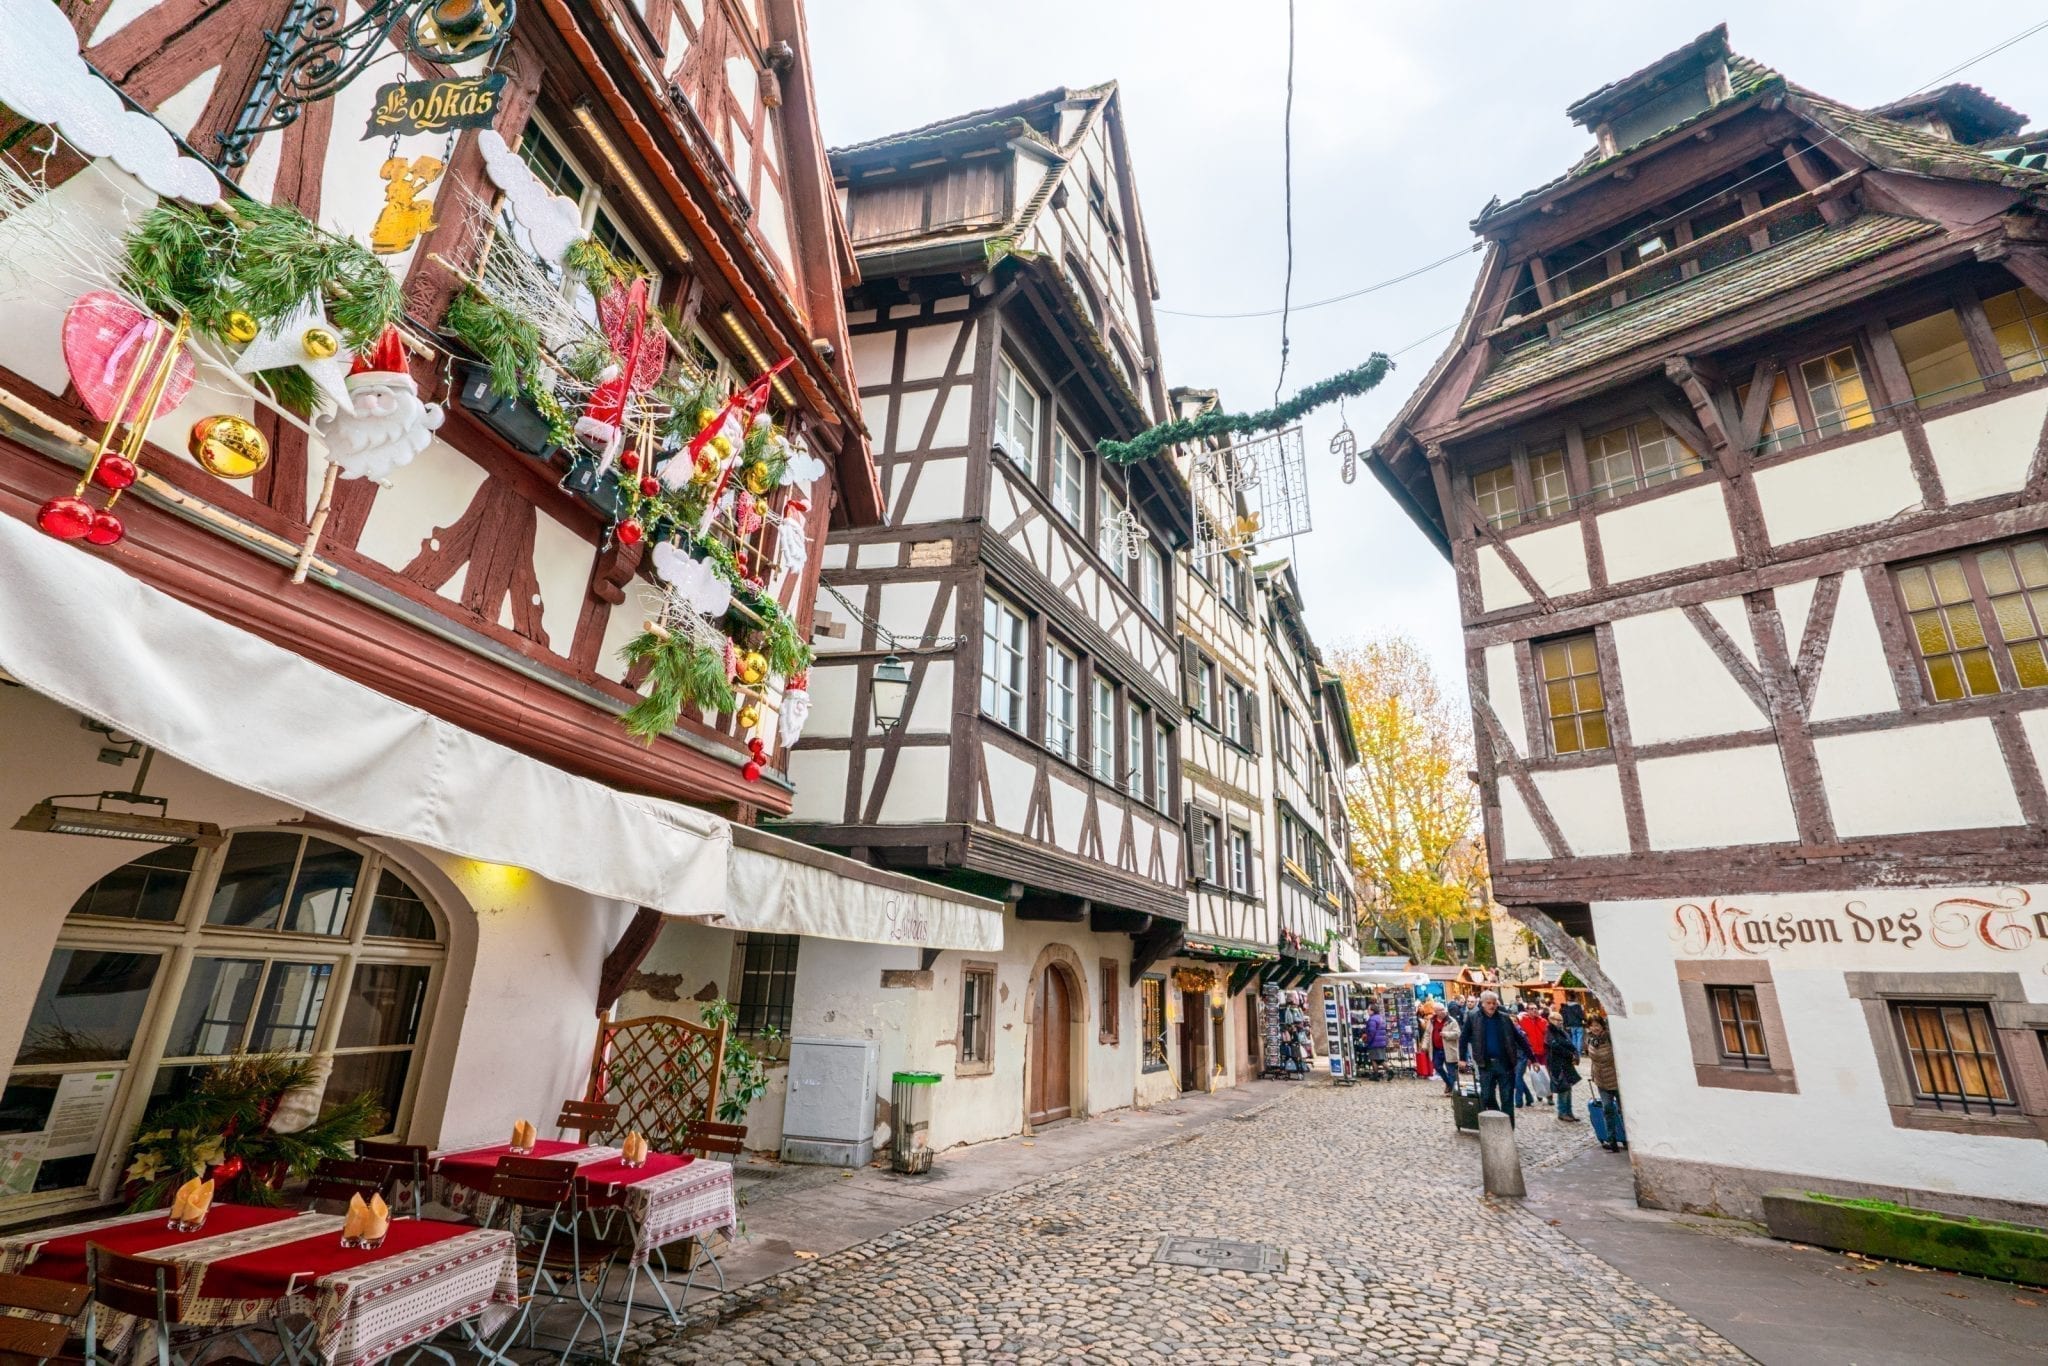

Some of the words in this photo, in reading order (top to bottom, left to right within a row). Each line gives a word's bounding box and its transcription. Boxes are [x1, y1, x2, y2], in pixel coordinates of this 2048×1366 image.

[375, 79, 495, 129] Lohkäs
[1671, 898, 1842, 956] Maison
[1844, 900, 1923, 950] des
